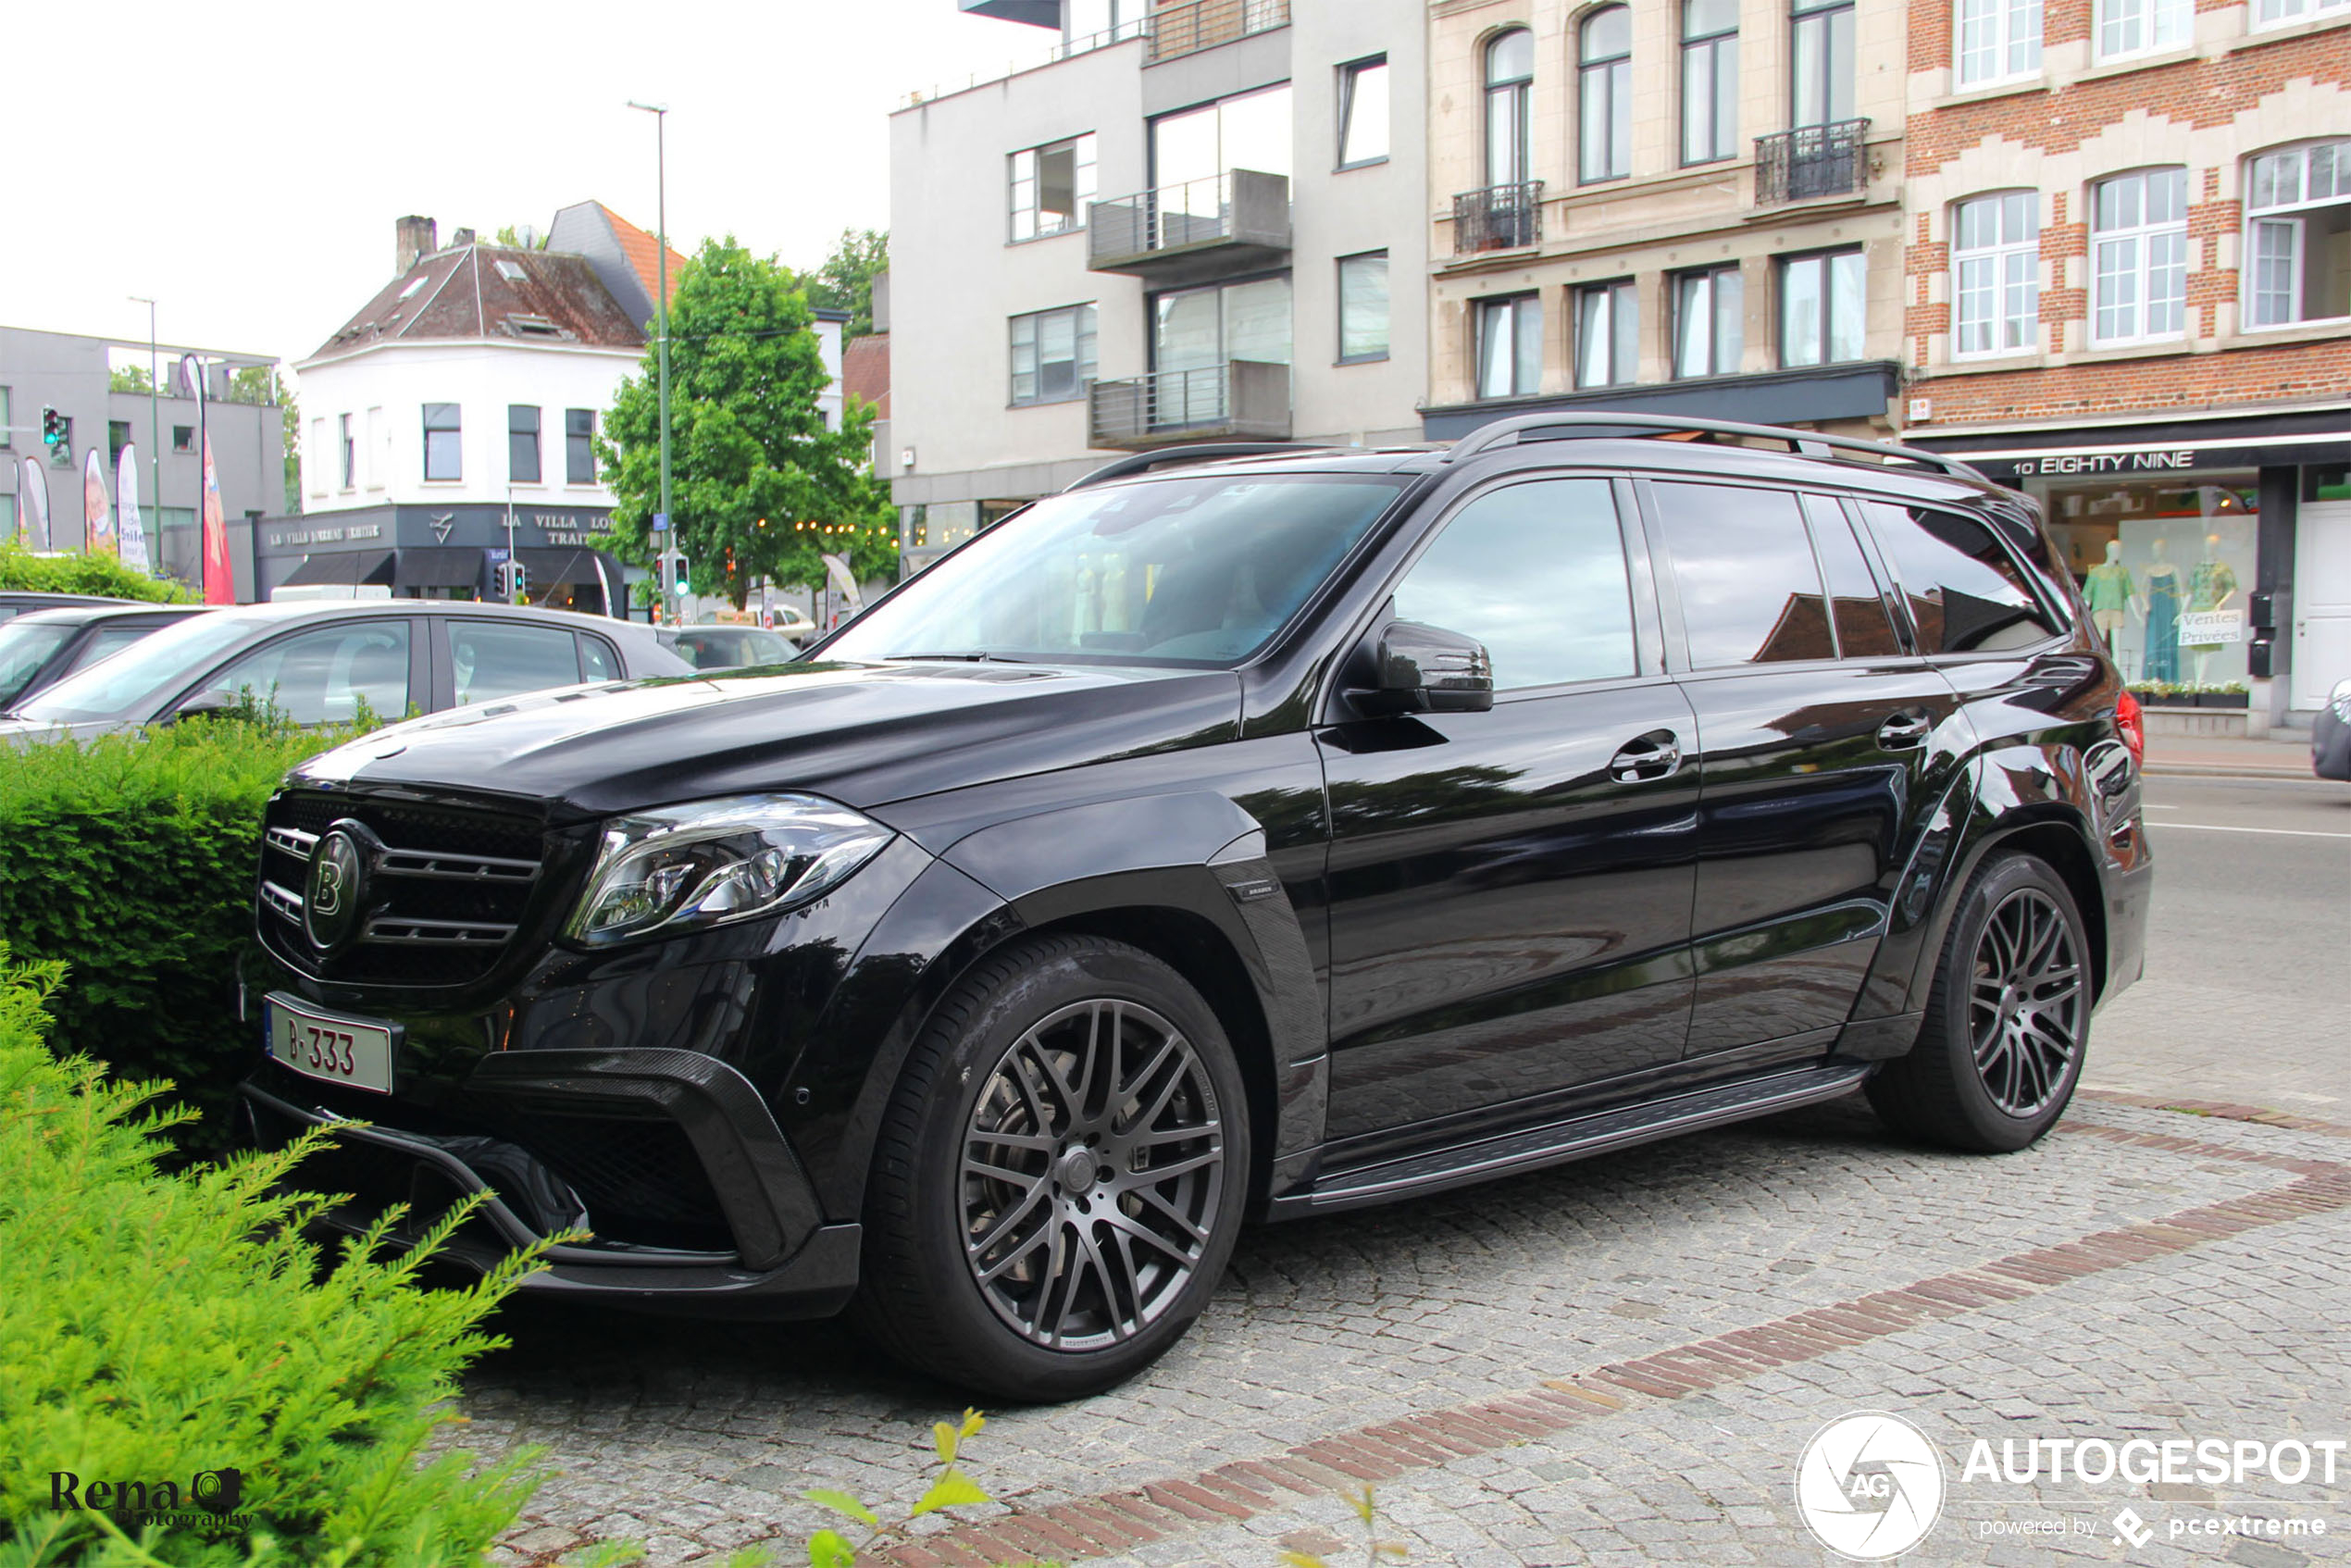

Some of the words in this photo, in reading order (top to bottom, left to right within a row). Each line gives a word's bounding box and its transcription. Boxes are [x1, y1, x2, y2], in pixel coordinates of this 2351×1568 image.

[2013, 463, 2034, 475] 10
[2040, 454, 2126, 474] EIGHTY
[2133, 451, 2195, 469] NINE
[502, 513, 521, 527] LA
[534, 515, 578, 529] VILLA
[2183, 614, 2239, 626] Ventes
[314, 860, 342, 915] B
